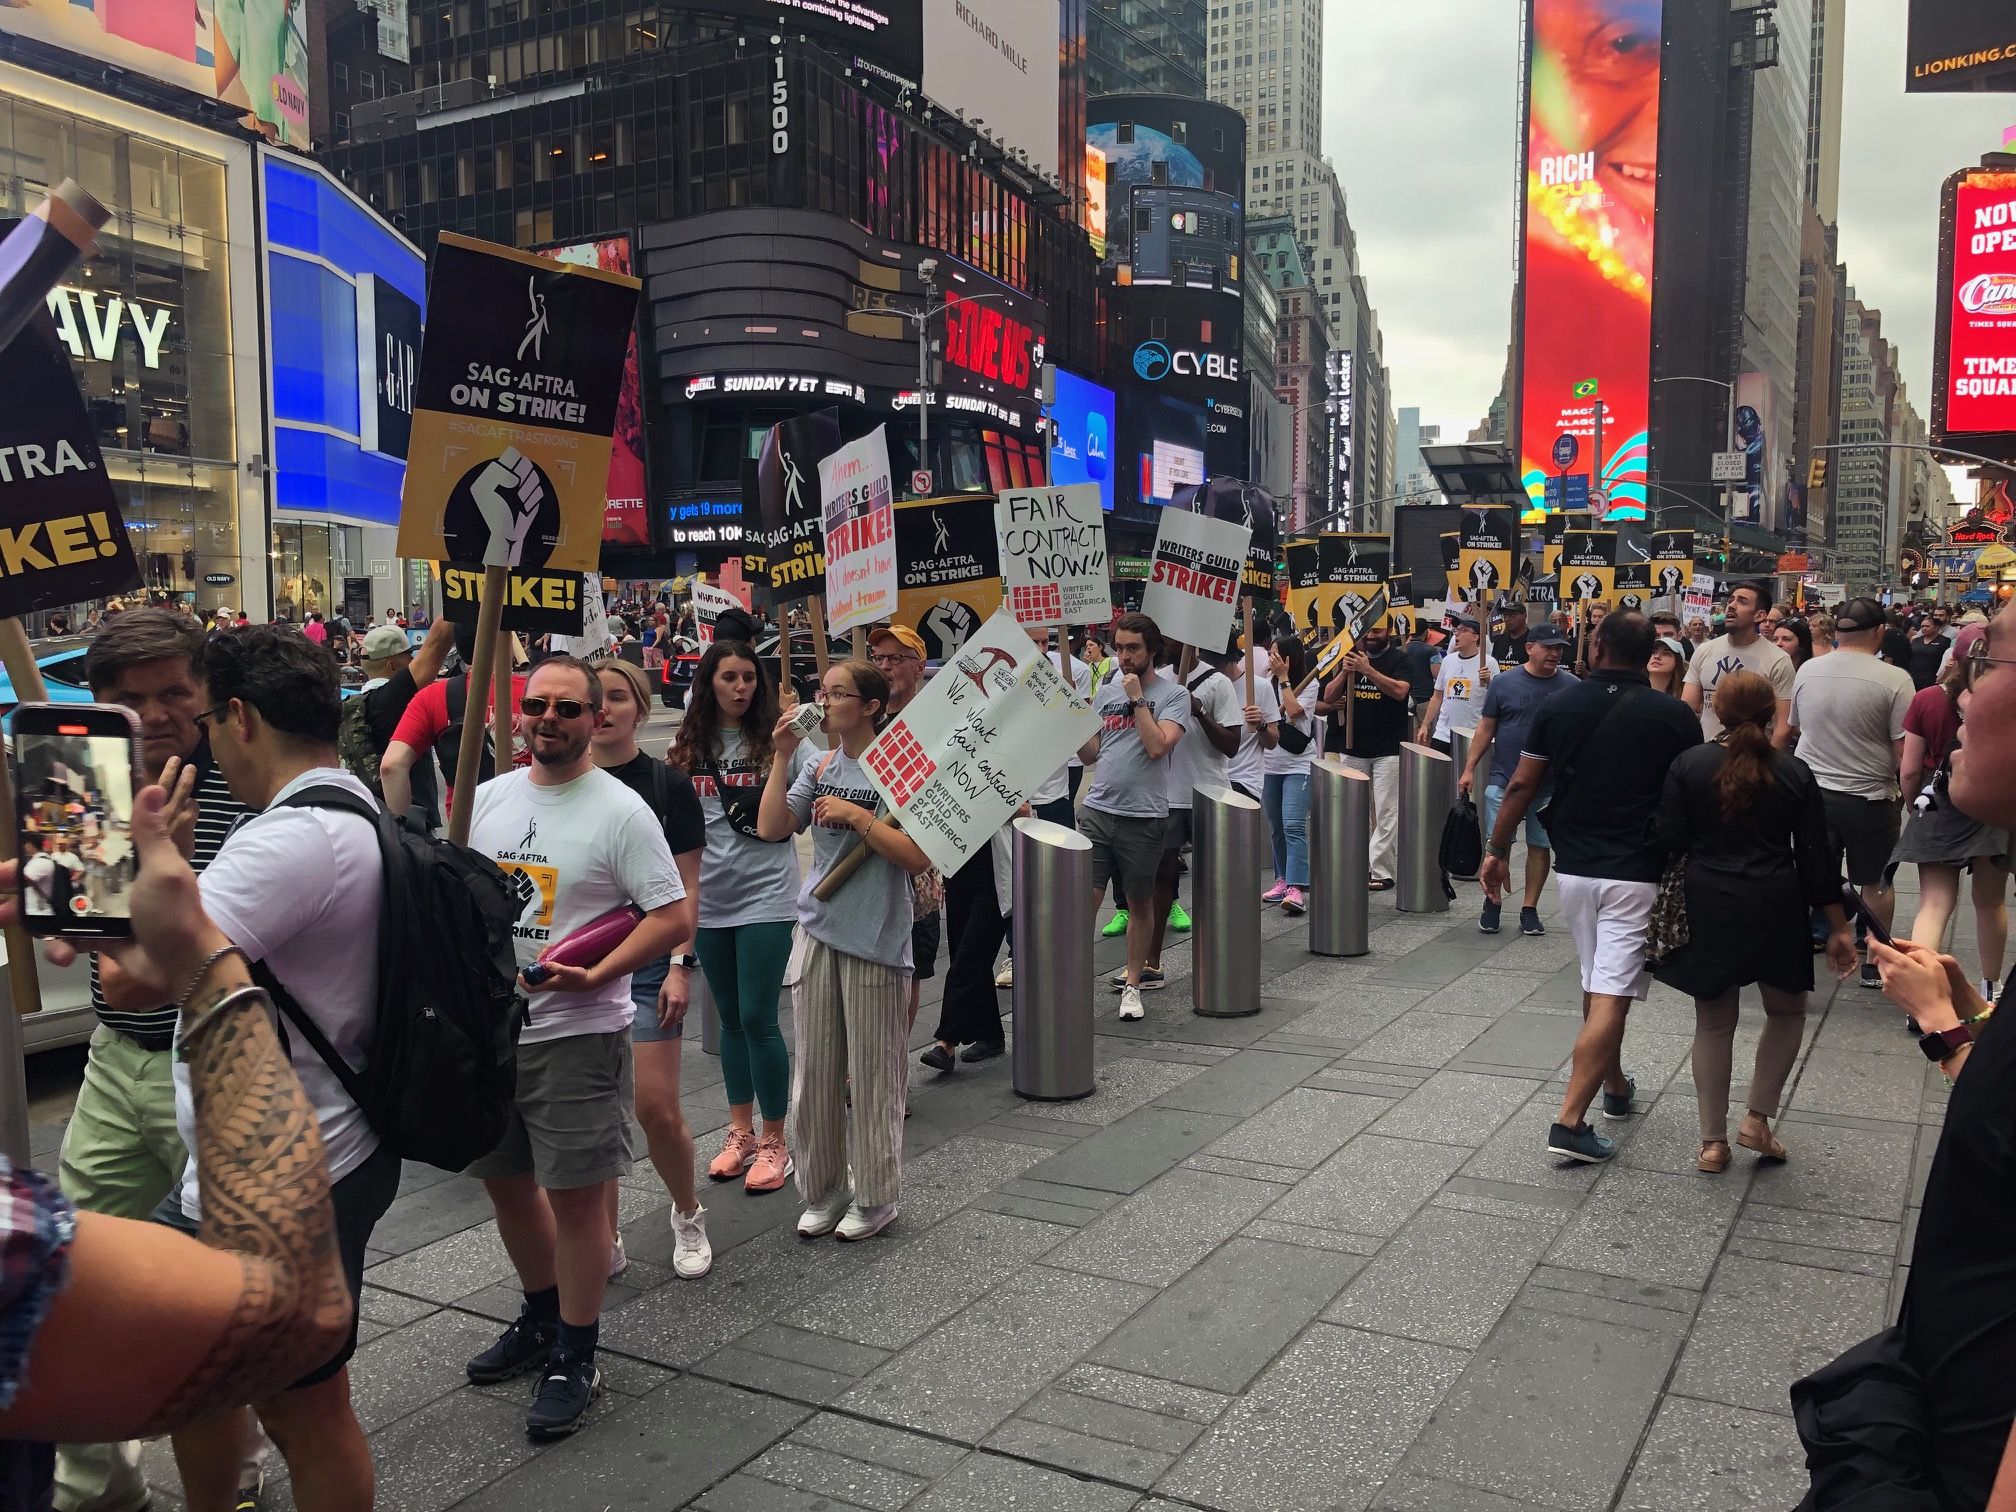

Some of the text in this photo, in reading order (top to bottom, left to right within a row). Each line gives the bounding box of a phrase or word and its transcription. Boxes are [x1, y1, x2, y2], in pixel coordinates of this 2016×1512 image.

[802, 1, 843, 21] combining
[845, 12, 875, 31] lightness
[851, 4, 889, 25] advantages
[956, 0, 1027, 74] RICHARD MILLE
[288, 91, 304, 117] NAVY
[772, 57, 788, 154] 1500
[1541, 151, 1594, 186] RICH
[1001, 318, 1033, 390] US
[1173, 351, 1238, 382] CYBLE
[386, 332, 414, 414] GAP
[724, 377, 785, 391] SUNDAY
[788, 378, 799, 391] 7
[800, 379, 819, 392] ET
[1339, 354, 1351, 396] Locker
[450, 384, 587, 424] ON STRIKE!
[945, 395, 987, 412] SUNDAY
[1088, 433, 1106, 459] Calm
[680, 504, 698, 520] gets
[700, 502, 710, 516] 19
[825, 475, 888, 520] WRITERS GUILD
[847, 506, 859, 519] ON
[1009, 494, 1083, 523] FAIR
[0, 511, 117, 577] KE!
[674, 529, 685, 542] to
[689, 527, 715, 542] reach
[794, 540, 814, 555] ON
[827, 504, 892, 567] STRIKE!
[1006, 525, 1102, 556] CONTRACT
[1480, 541, 1502, 549] STRIKE!
[1955, 532, 1995, 541] Hard Rock
[1028, 551, 1104, 578] NOW!!
[1159, 539, 1239, 571] WRITERS GUILD
[1190, 562, 1200, 571] ON
[444, 569, 576, 611] STKE!
[904, 565, 984, 585] ON STRIKE!
[1062, 585, 1094, 593] WRITERS
[1152, 560, 1237, 605] STRIKE!
[714, 596, 724, 604] DO
[1072, 598, 1106, 607] AMERICA
[947, 675, 968, 705] We
[947, 727, 1023, 807] fair contracts
[947, 761, 990, 800] NOW
[925, 788, 952, 820] GUILD
[933, 779, 971, 824] WRITERS
[909, 804, 935, 831] EAST
[917, 797, 968, 854] of AMERICA
